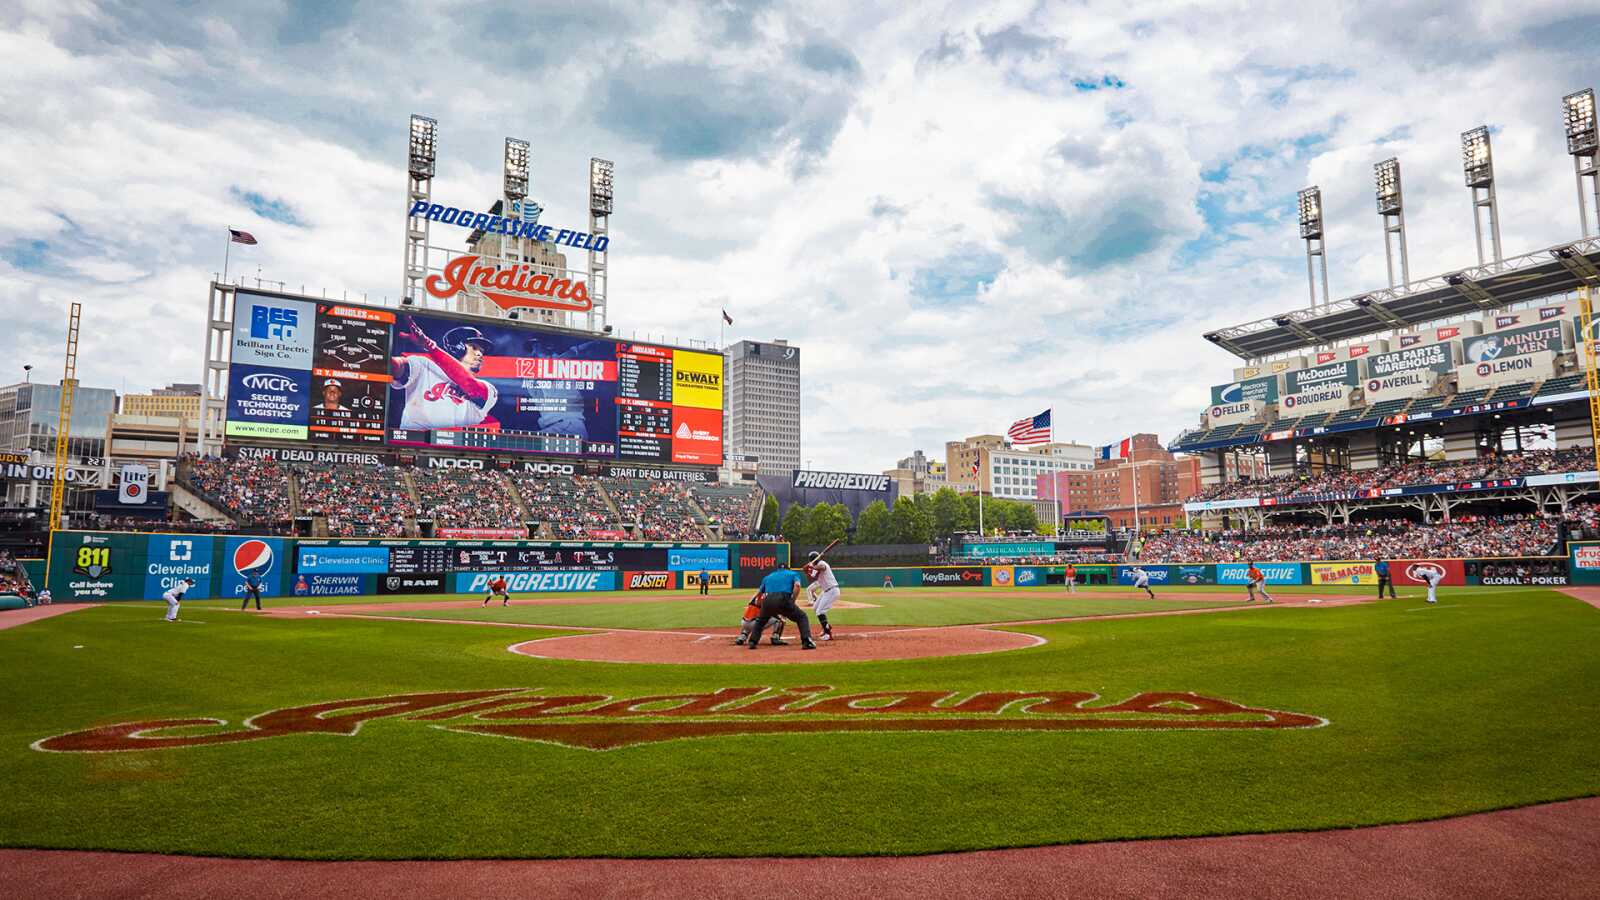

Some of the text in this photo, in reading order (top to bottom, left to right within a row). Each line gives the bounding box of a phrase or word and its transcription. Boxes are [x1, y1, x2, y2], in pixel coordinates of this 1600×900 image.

[408, 201, 610, 252] PROGRESSIVE FIELD
[425, 255, 593, 312] Indians
[1503, 327, 1560, 347] MINUTE
[237, 339, 274, 350] Brilliant
[276, 343, 310, 354] Electric
[254, 349, 275, 358] Sign
[1516, 342, 1548, 354] MEN
[1377, 345, 1441, 365] CAR PARTS
[516, 357, 536, 378] 12
[543, 359, 604, 380] LINDOR
[1375, 353, 1446, 374] WAREHOUSE
[1492, 357, 1533, 374] LEMON
[1296, 363, 1347, 382] McDonald
[1382, 374, 1422, 389] AVERILL
[251, 393, 288, 402] SECURE
[1296, 390, 1342, 405] BOUDREAU
[237, 400, 300, 411] TECHNOLOGY
[244, 407, 293, 418] LOGISTICS
[1222, 403, 1250, 416] FELLER
[235, 425, 299, 435] www.mcpc.com
[239, 447, 278, 459] START
[281, 449, 314, 461] DEAD
[429, 457, 484, 470] NOCO
[525, 462, 574, 474] NOCO
[7, 463, 76, 481] IN OHIO
[610, 467, 637, 478] START
[638, 469, 661, 480] DEAD
[794, 470, 890, 491] PROGRESSIVE
[78, 547, 109, 568] 811
[361, 557, 384, 565] Clinic
[740, 555, 776, 570] meijer
[148, 563, 210, 575] Cleveland
[312, 576, 359, 585] SHERWIN
[630, 574, 668, 589] BLASTER
[922, 573, 961, 583] KeyBank
[1483, 577, 1567, 585] GLOBAL POKER
[74, 589, 91, 597] you
[235, 582, 268, 595] pesi
[30, 686, 1330, 752] Indians
